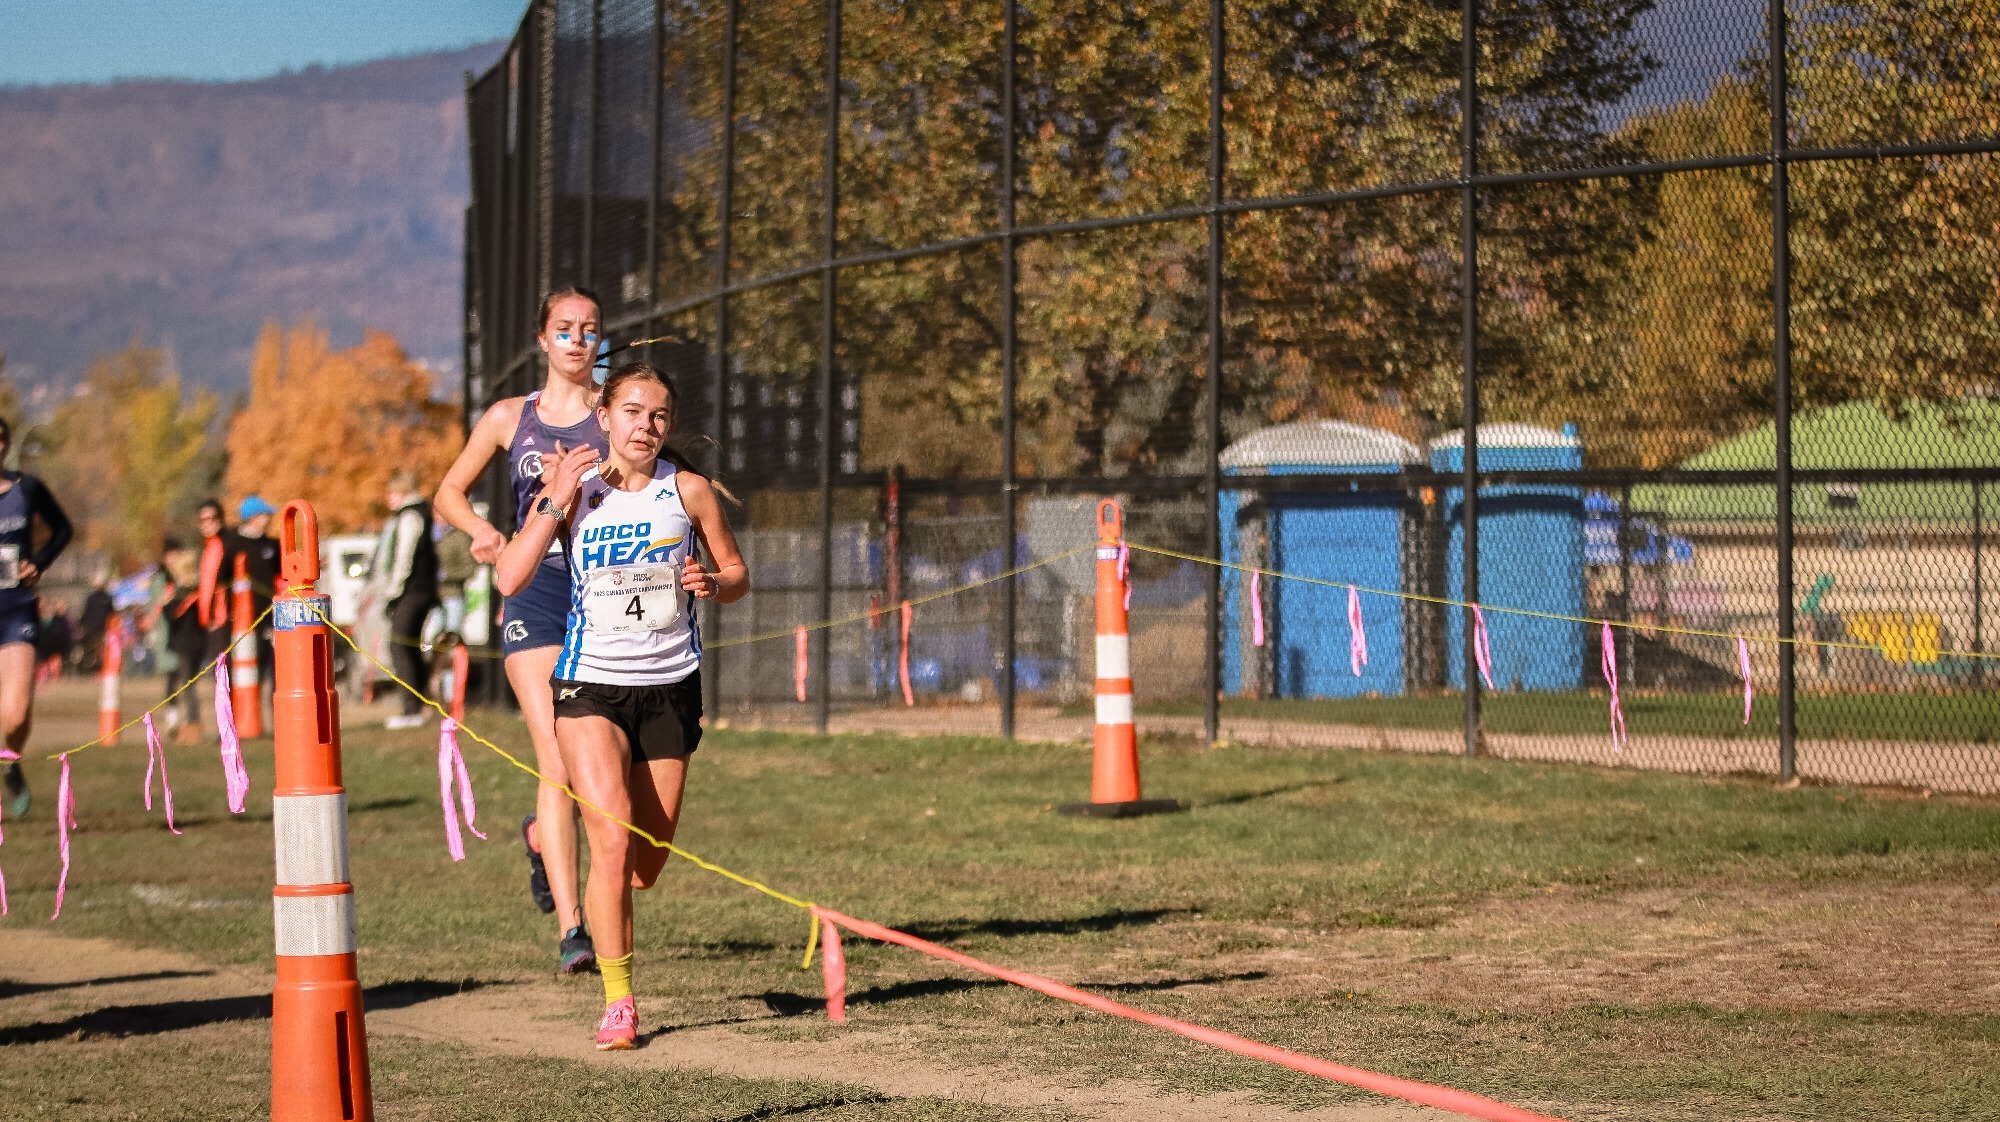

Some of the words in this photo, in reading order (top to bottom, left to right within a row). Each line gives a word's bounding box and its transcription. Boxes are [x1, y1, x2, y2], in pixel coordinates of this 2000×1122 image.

[582, 521, 652, 544] UBCO
[582, 536, 682, 571] HEAT
[625, 595, 646, 621] 4
